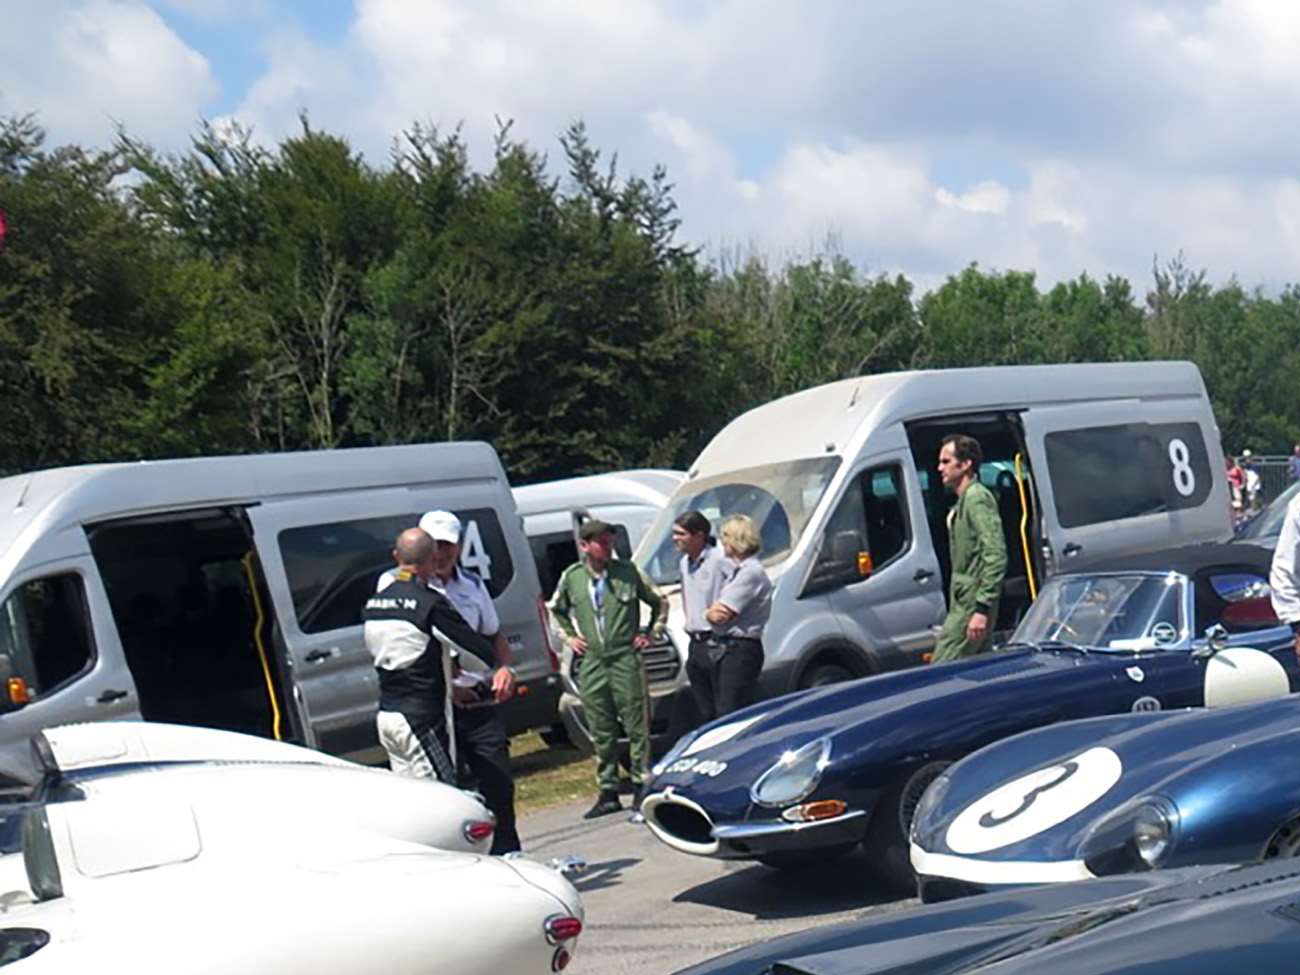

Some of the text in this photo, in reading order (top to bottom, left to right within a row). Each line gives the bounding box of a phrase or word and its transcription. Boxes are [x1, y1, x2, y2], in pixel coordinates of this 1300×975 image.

[1168, 438, 1196, 497] 8
[460, 519, 492, 580] 4
[978, 761, 1080, 829] 3
